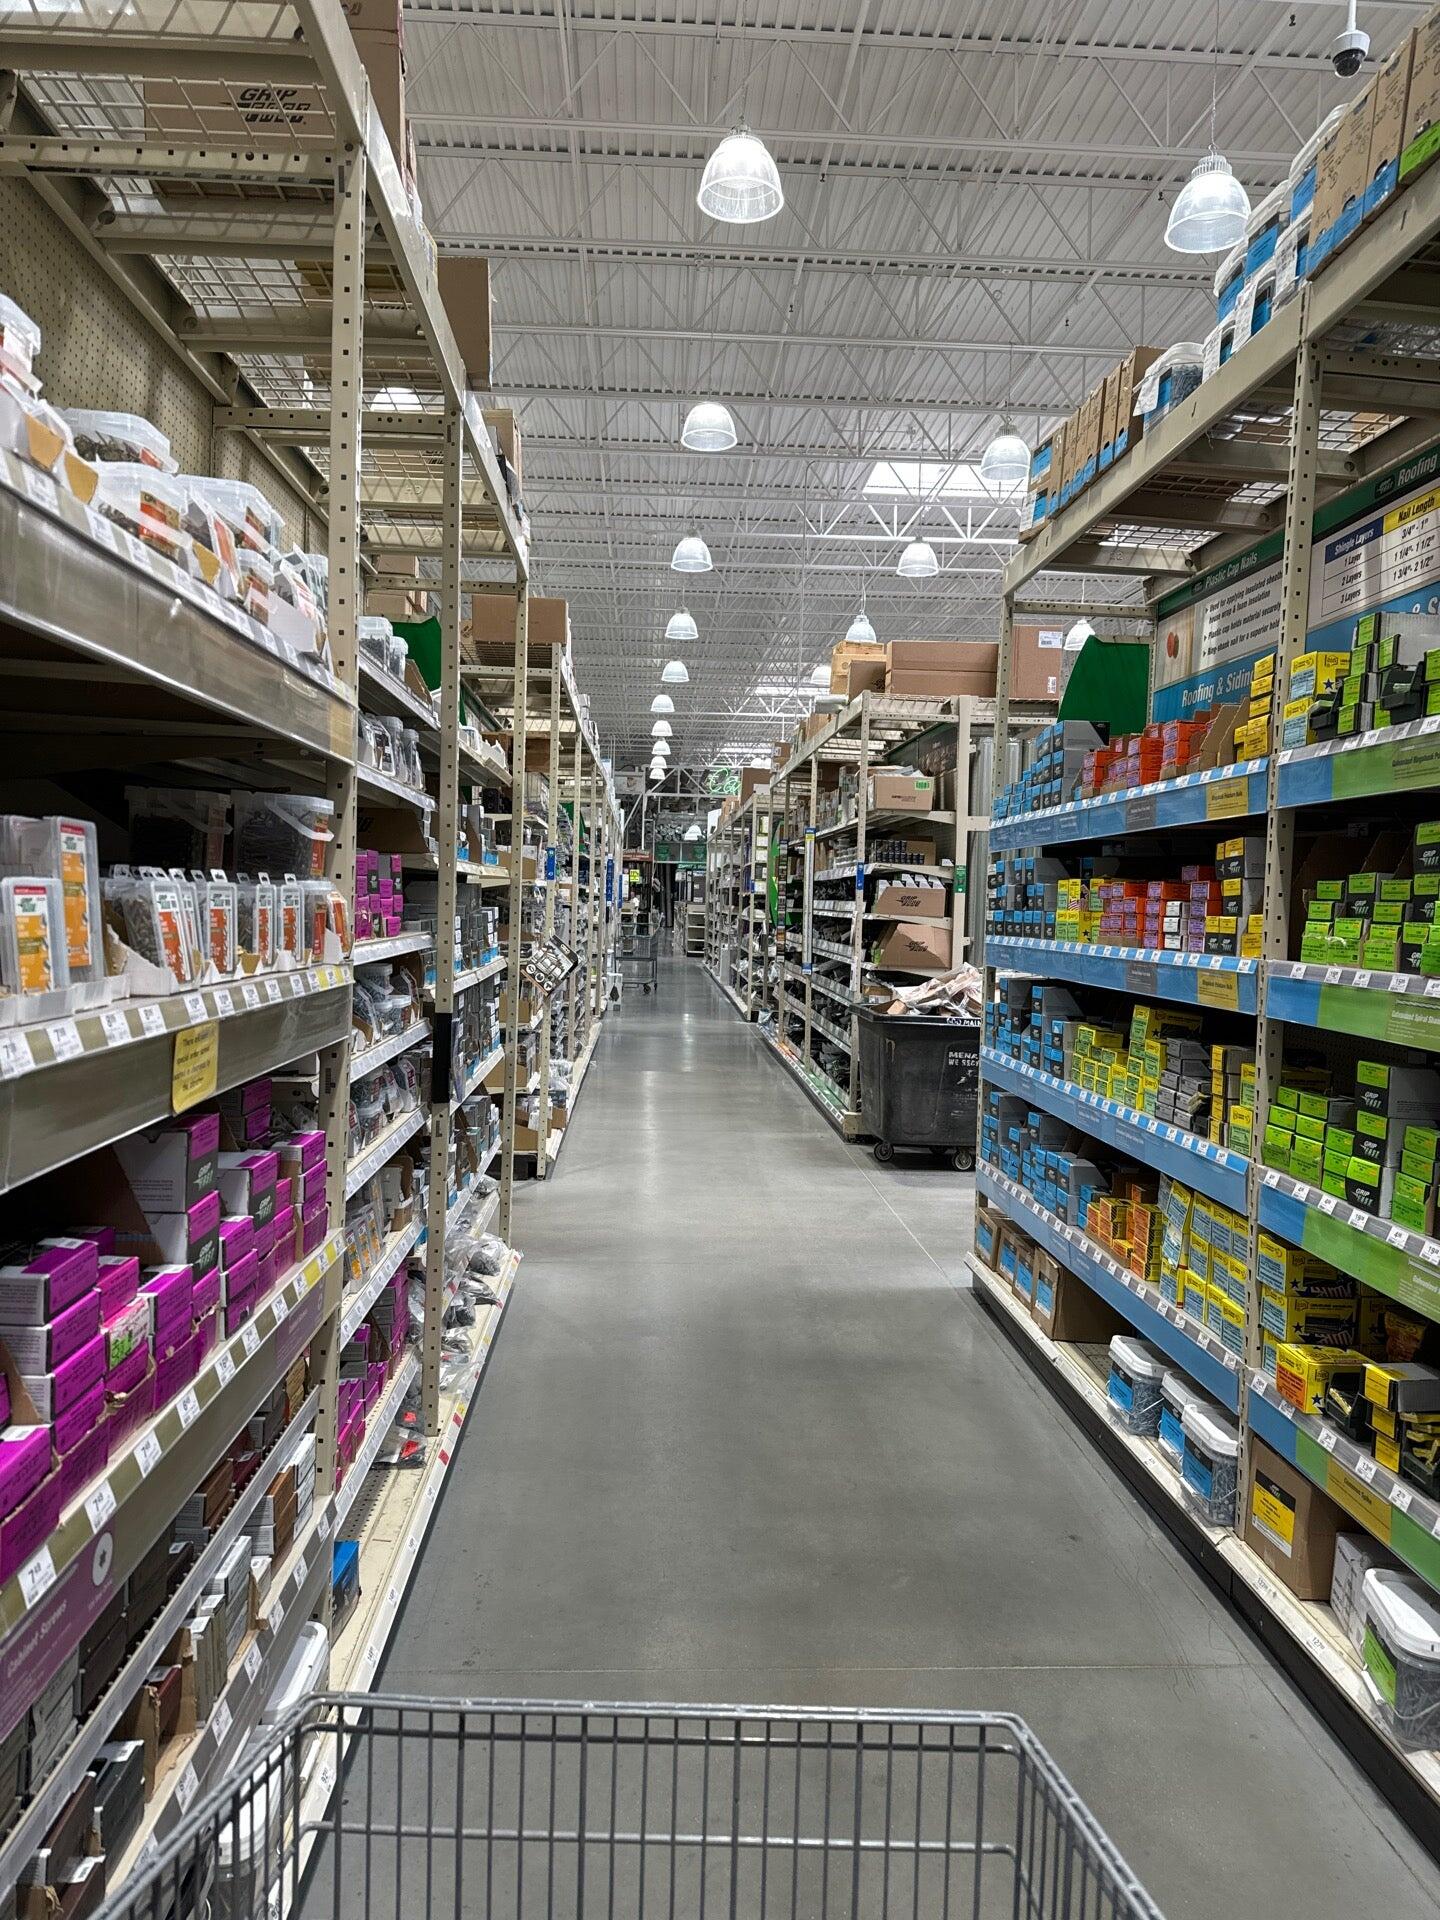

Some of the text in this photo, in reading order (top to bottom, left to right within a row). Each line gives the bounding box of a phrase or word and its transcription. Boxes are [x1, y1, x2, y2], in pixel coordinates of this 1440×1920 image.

[239, 88, 298, 102] GRIP
[1397, 453, 1438, 487] Roofing
[1398, 495, 1436, 524] Nail Length
[1355, 527, 1375, 545] Layers
[1348, 552, 1362, 566] Layer
[1205, 570, 1226, 589] Plastic
[1227, 564, 1240, 579] Cap
[1240, 551, 1258, 569] Nails
[1345, 570, 1362, 585] Layers
[1227, 590, 1245, 605] applying
[1245, 580, 1266, 595] insulated
[1266, 571, 1282, 586] sheath
[1345, 588, 1361, 602] Layers
[1221, 608, 1232, 620] wrap
[1236, 601, 1248, 611] foam
[1248, 589, 1271, 606] insulation
[1208, 628, 1222, 640] Plastic
[1243, 610, 1261, 624] material
[1250, 625, 1269, 638] superior
[1181, 667, 1253, 707] Roofing & Sidin
[1422, 849, 1436, 858] GRIP
[948, 1051, 980, 1060] MENA
[1364, 1091, 1379, 1099] GRIP
[1363, 1140, 1378, 1148] GRIP
[1355, 1188, 1371, 1196] GRIP
